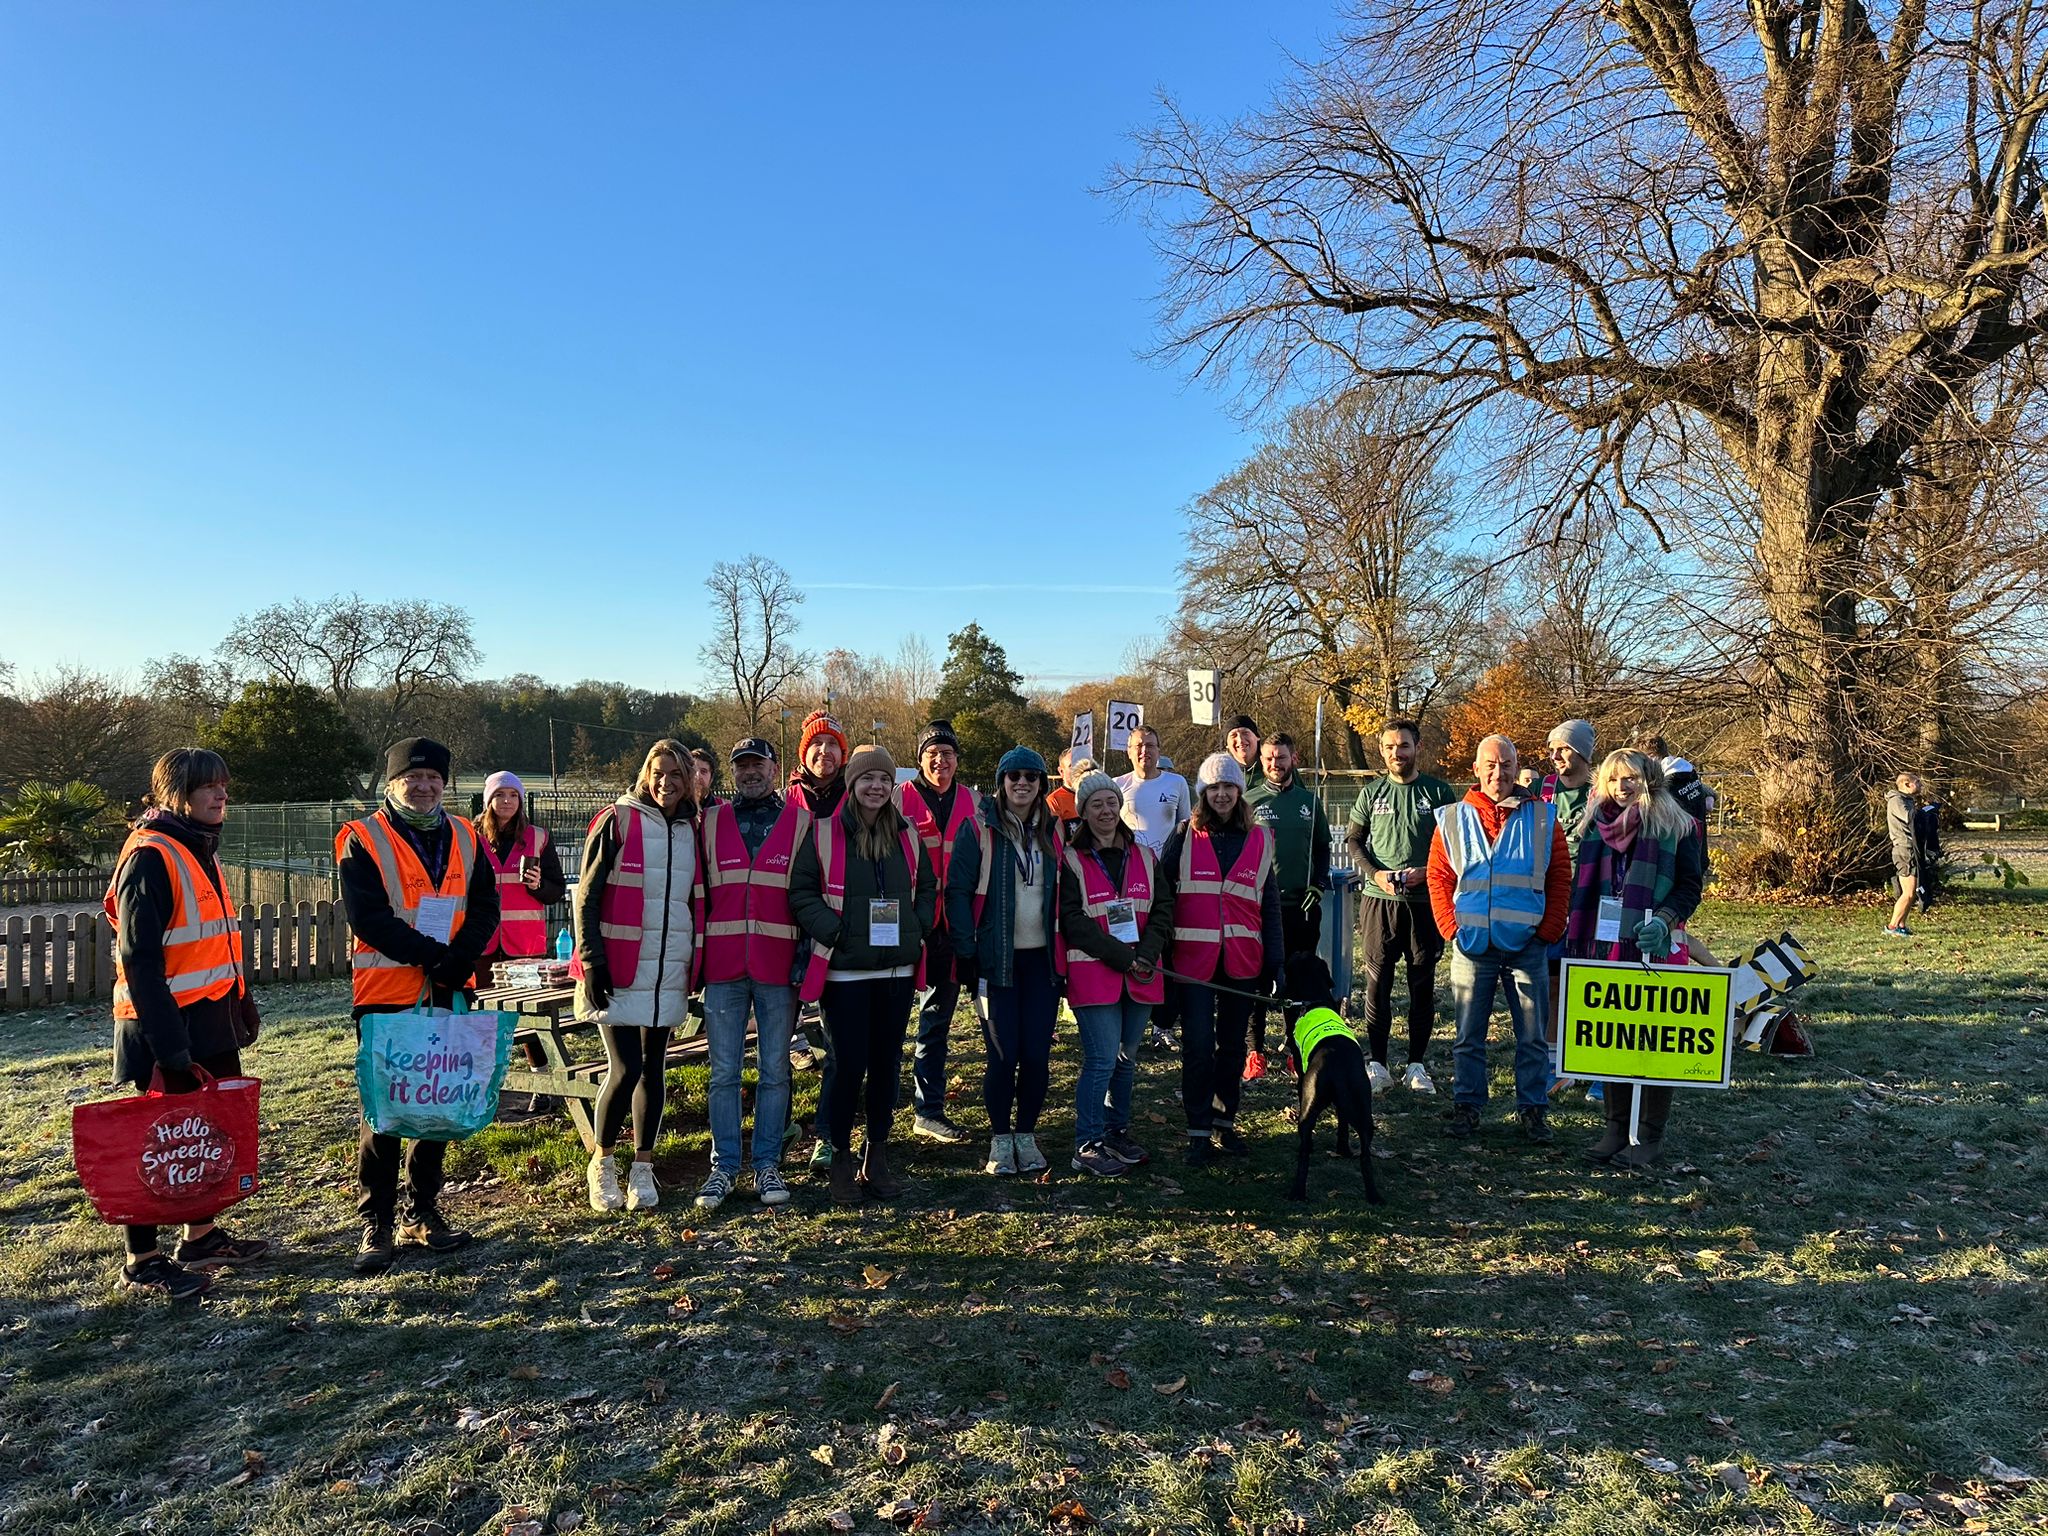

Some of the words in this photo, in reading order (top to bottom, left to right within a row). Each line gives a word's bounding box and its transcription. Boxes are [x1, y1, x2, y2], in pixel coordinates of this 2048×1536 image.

[1192, 680, 1217, 703] 30
[1112, 711, 1140, 732] 20
[1073, 724, 1091, 747] 22
[1678, 780, 1701, 796] northern
[1687, 789, 1701, 800] rock
[1583, 981, 1711, 1016] CAUTION
[1575, 1019, 1716, 1056] RUNNERS
[384, 1038, 474, 1081] keeping
[1684, 1062, 1715, 1076] parkrun
[389, 1074, 411, 1105] it
[415, 1073, 481, 1106] clean
[156, 1116, 210, 1143] Hello
[142, 1138, 223, 1170] Sweetie
[167, 1161, 205, 1186] Pie!
